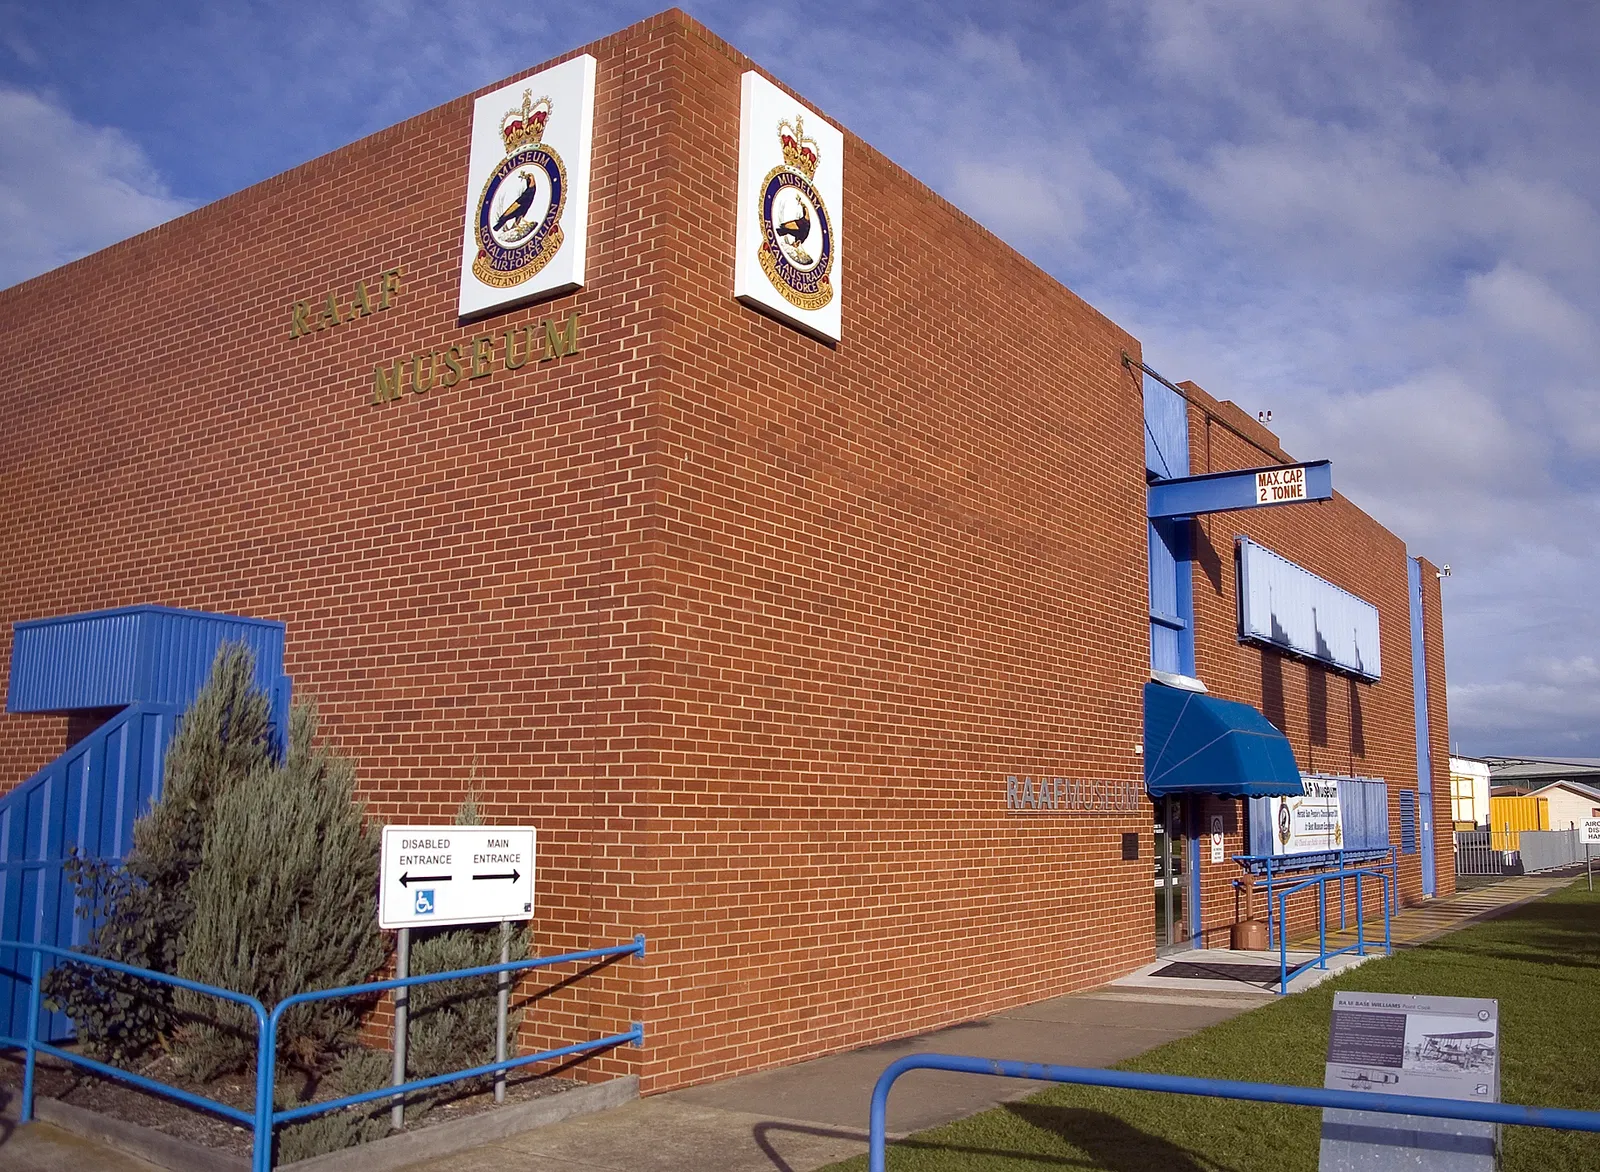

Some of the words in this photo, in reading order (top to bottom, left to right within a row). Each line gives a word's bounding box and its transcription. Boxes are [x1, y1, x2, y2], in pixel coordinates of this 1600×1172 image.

[498, 151, 551, 180] MUSEUM
[777, 173, 820, 211] MUSEUM
[480, 225, 501, 260] ROYAL
[500, 203, 558, 260] AUSTRALIAN
[473, 263, 504, 286] COLLECT
[502, 275, 521, 287] AND
[523, 237, 563, 280] PRESERVE
[490, 257, 509, 271] AIR
[509, 247, 543, 270] FORCE
[764, 220, 784, 266] ROYAL
[783, 254, 829, 283] AUSTRALIAN
[759, 251, 785, 294] COLLECT
[785, 291, 802, 306] AND
[803, 287, 833, 309] PRESERVE
[775, 264, 791, 285] AIR
[791, 278, 818, 293] FORCE
[289, 268, 402, 340] RAAF
[371, 310, 583, 406] MUSEUM
[1260, 489, 1267, 501] 2
[1272, 484, 1303, 500] TONNE
[1313, 782, 1337, 798] Museum
[402, 839, 451, 849] DISABLED
[487, 839, 510, 848] MAIN
[400, 855, 452, 865] ENTRANCE
[473, 853, 521, 864] ENTRANCE
